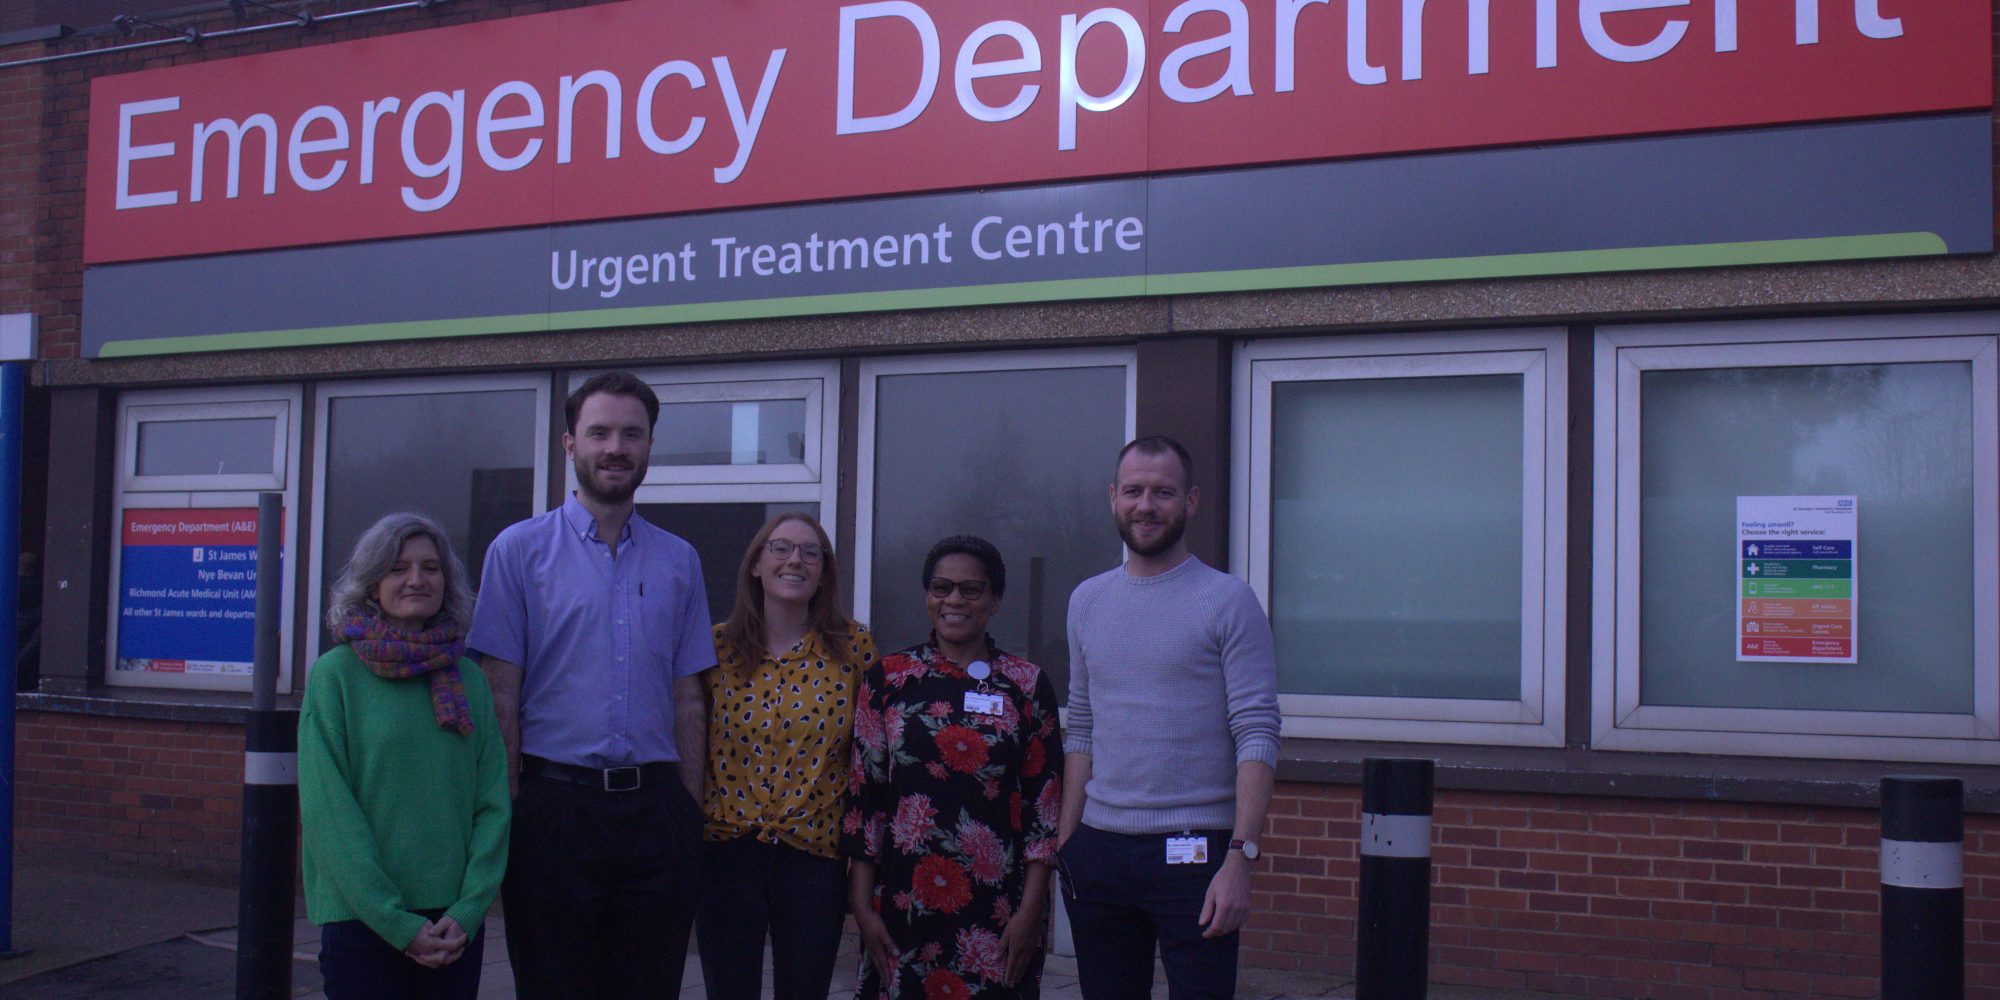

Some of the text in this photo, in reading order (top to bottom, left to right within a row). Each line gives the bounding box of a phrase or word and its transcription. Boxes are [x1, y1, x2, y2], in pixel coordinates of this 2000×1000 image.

[115, 0, 1905, 212] Emergency Departme
[550, 212, 1144, 299] Urgent Treatment Centre
[131, 520, 256, 535] Emergency Department (A&E)
[1742, 521, 1766, 529] Feeling
[208, 550, 218, 561] St
[219, 550, 247, 561] James
[198, 569, 215, 582] Nye
[217, 569, 244, 580] Bevan
[129, 588, 256, 600] Richmond Acute Medical Unit (AM
[123, 607, 256, 620] All other St James wards and departm
